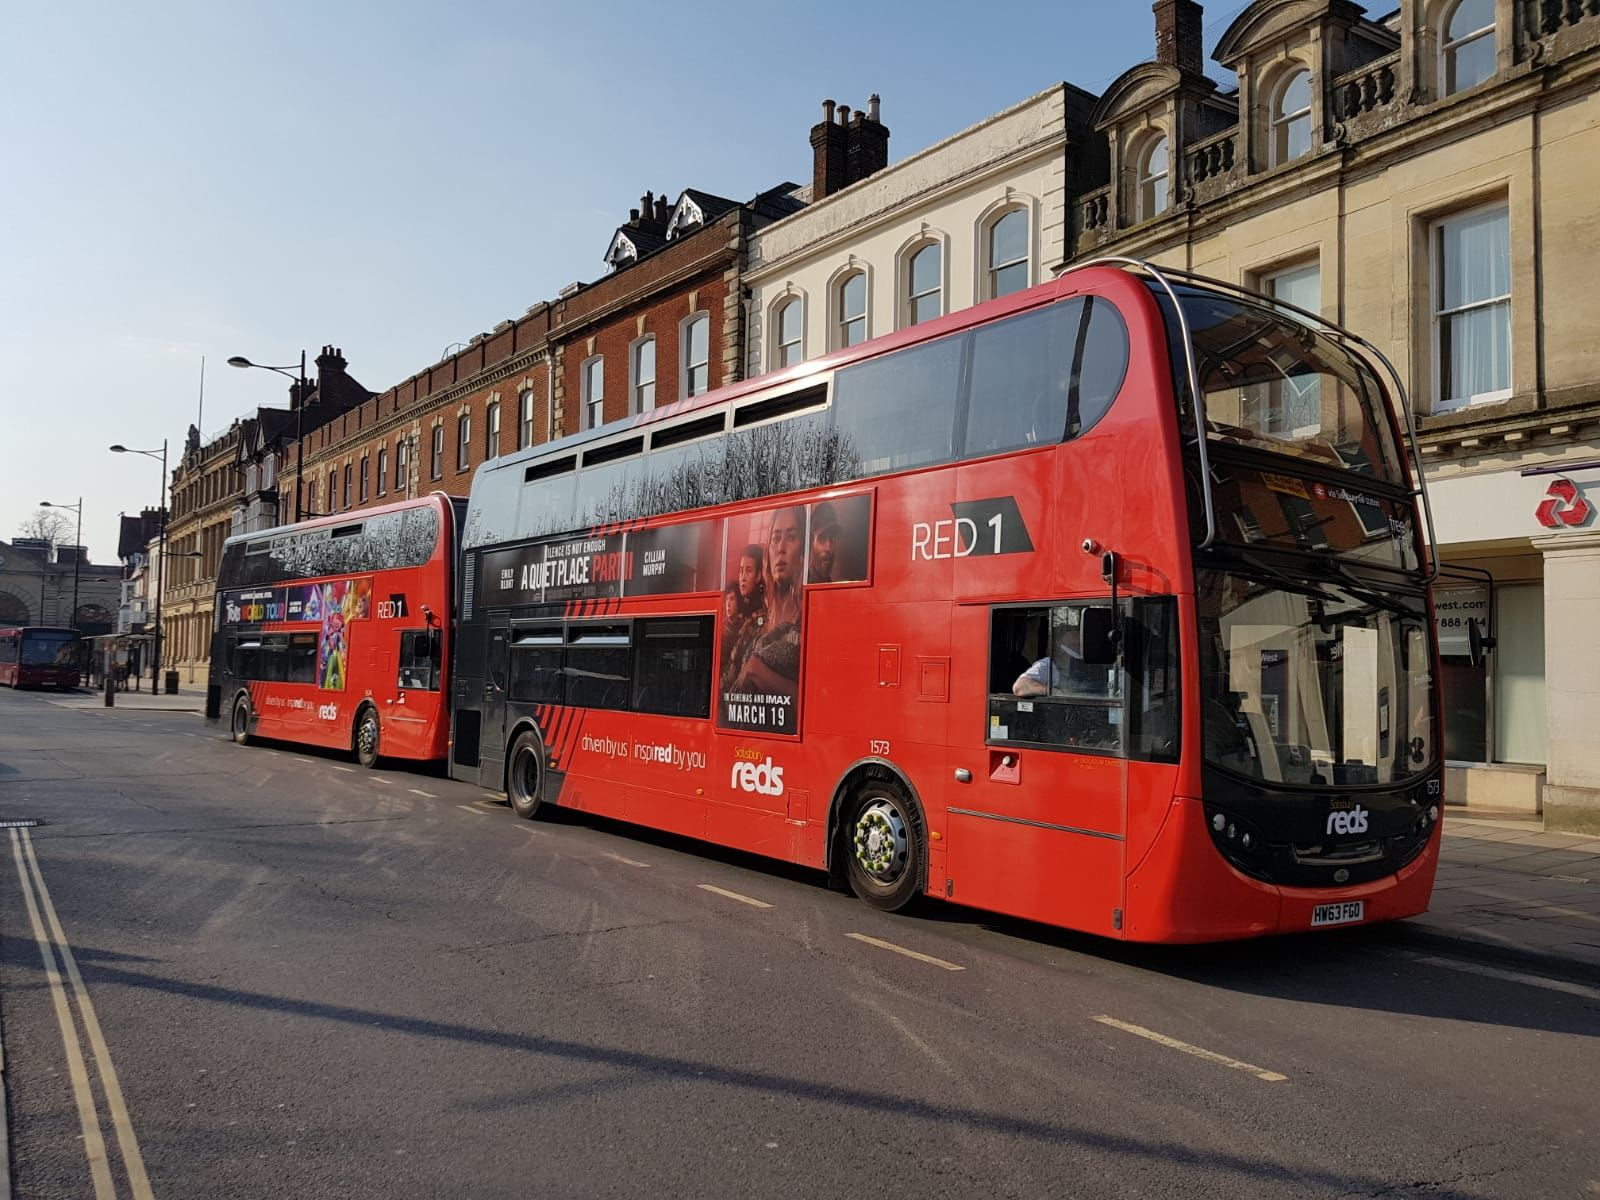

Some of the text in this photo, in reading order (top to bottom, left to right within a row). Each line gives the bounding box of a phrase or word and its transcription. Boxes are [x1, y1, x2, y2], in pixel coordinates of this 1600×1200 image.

[911, 513, 1002, 561] RED 1
[546, 539, 606, 559] ILENCE IS NOT ENOUGH
[644, 549, 666, 564] CILLIAN
[520, 564, 528, 591] A
[557, 556, 590, 588] PLACE
[592, 552, 621, 583] PART
[643, 562, 666, 577] MURPHY
[377, 600, 403, 619] RED 1
[1441, 618, 1461, 627] 888
[730, 693, 753, 703] CINEMAS
[754, 694, 765, 704] AND
[766, 695, 791, 706] IMAX
[318, 702, 337, 721] reds
[728, 703, 785, 727] MARCH 19
[581, 733, 706, 771] driven by us inspired by you
[869, 739, 890, 756] 1573
[730, 756, 785, 797] reds
[1426, 779, 1440, 795] 1573
[1326, 804, 1369, 836] reds
[1313, 902, 1360, 923] HW63 FGO
